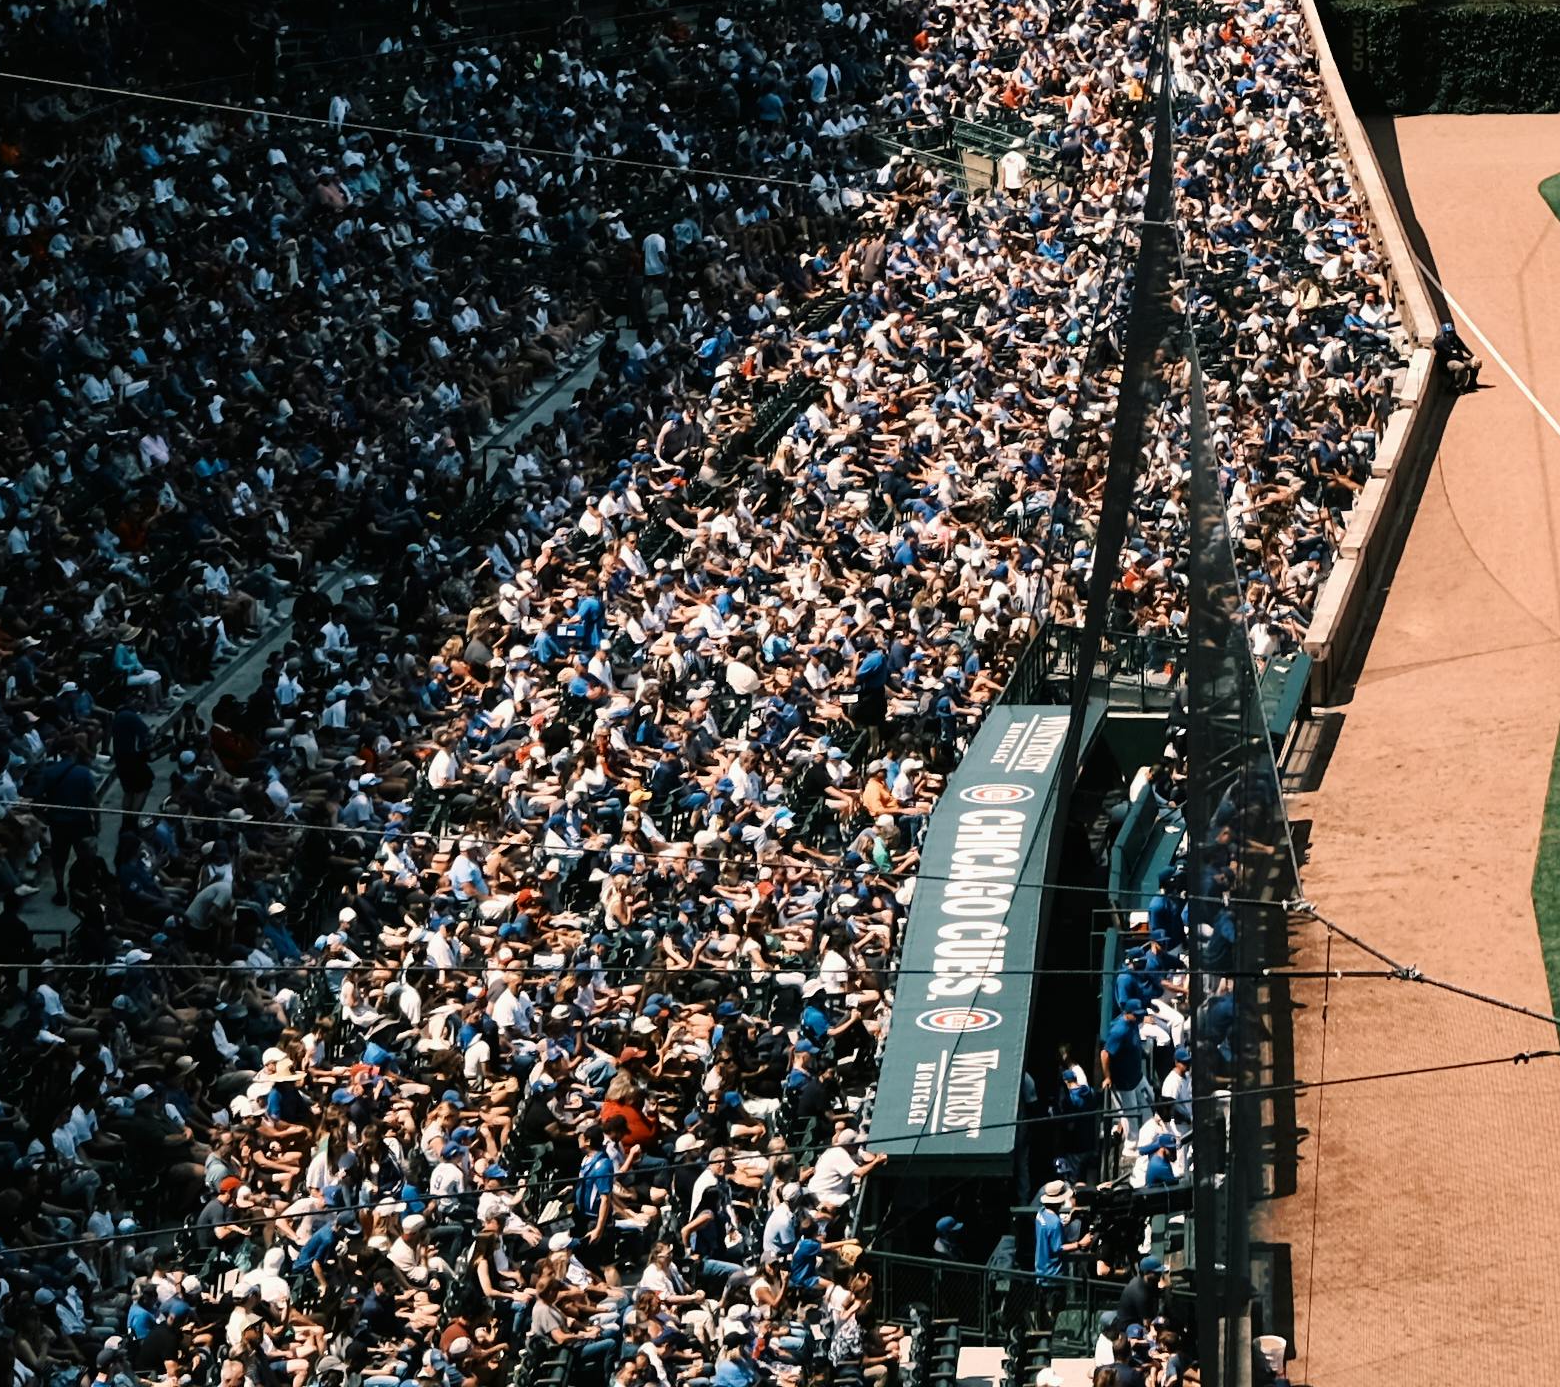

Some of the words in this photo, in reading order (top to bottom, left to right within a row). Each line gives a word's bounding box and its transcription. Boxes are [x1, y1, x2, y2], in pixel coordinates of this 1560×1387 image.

[1019, 715, 1071, 775] WINTRUST
[939, 808, 1027, 918] CHICAGO
[907, 1062, 939, 1126] MORTGAGE
[942, 1048, 1001, 1139] WINTRUST
